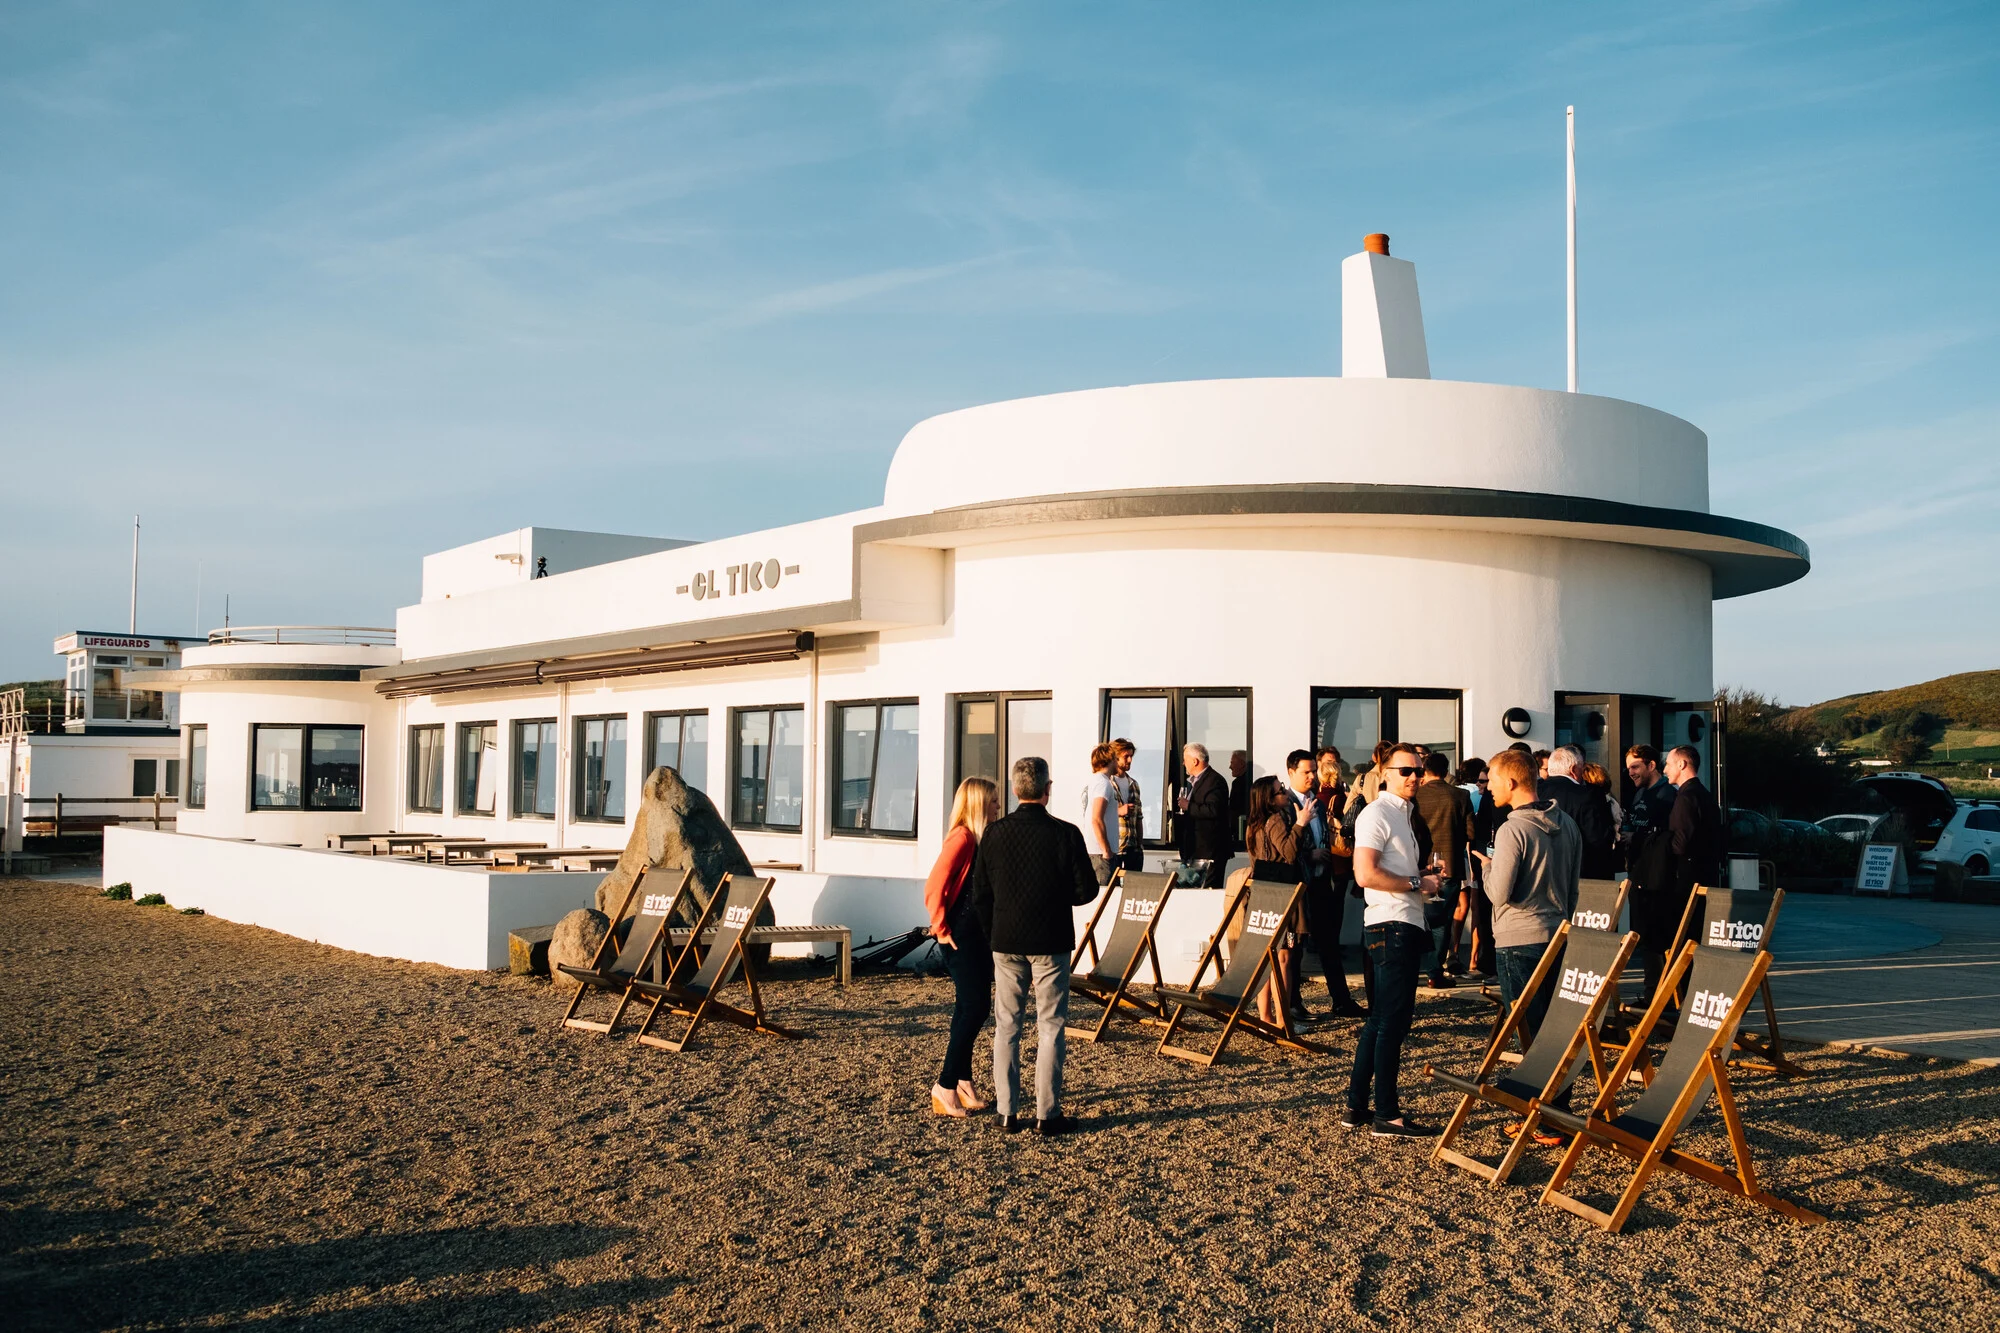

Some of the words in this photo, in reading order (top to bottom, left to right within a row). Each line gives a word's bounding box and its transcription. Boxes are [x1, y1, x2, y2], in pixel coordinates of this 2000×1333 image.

[726, 558, 781, 595] TICO
[84, 637, 151, 648] LIFEGUARDS
[1123, 898, 1135, 913] El
[1248, 909, 1262, 927] El
[1709, 920, 1725, 938] El
[1708, 938, 1731, 947] Beach
[1563, 968, 1579, 991] El
[1559, 989, 1579, 1002] Beach
[1692, 990, 1709, 1014] El
[1688, 1014, 1710, 1028] Beach
